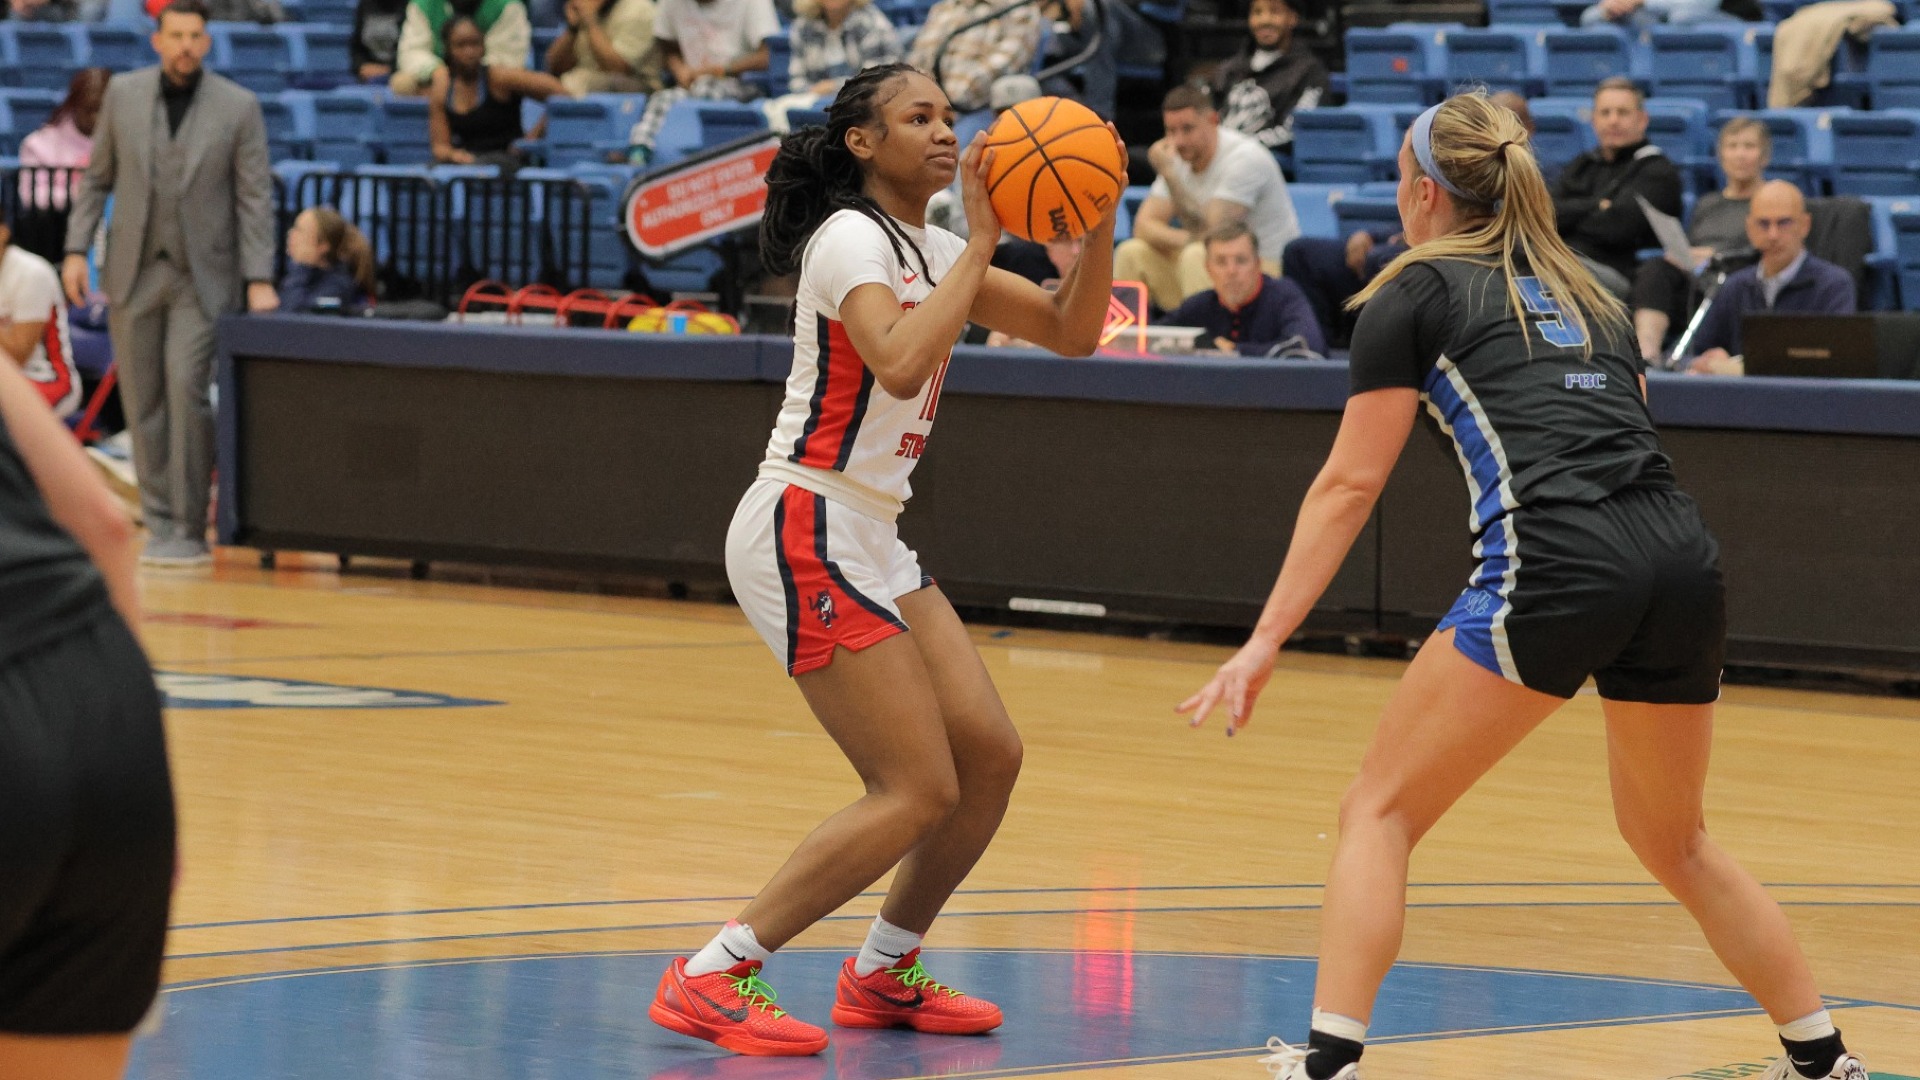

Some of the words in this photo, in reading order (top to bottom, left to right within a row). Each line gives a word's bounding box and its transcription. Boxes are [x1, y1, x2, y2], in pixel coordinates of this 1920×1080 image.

[688, 173, 714, 195] NOT
[716, 159, 755, 187] ENTER
[642, 192, 716, 228] AUTHORIZED
[701, 203, 734, 227] ONLY
[1512, 275, 1590, 348] 5
[1564, 373, 1607, 390] PBC
[894, 432, 929, 460] STA
